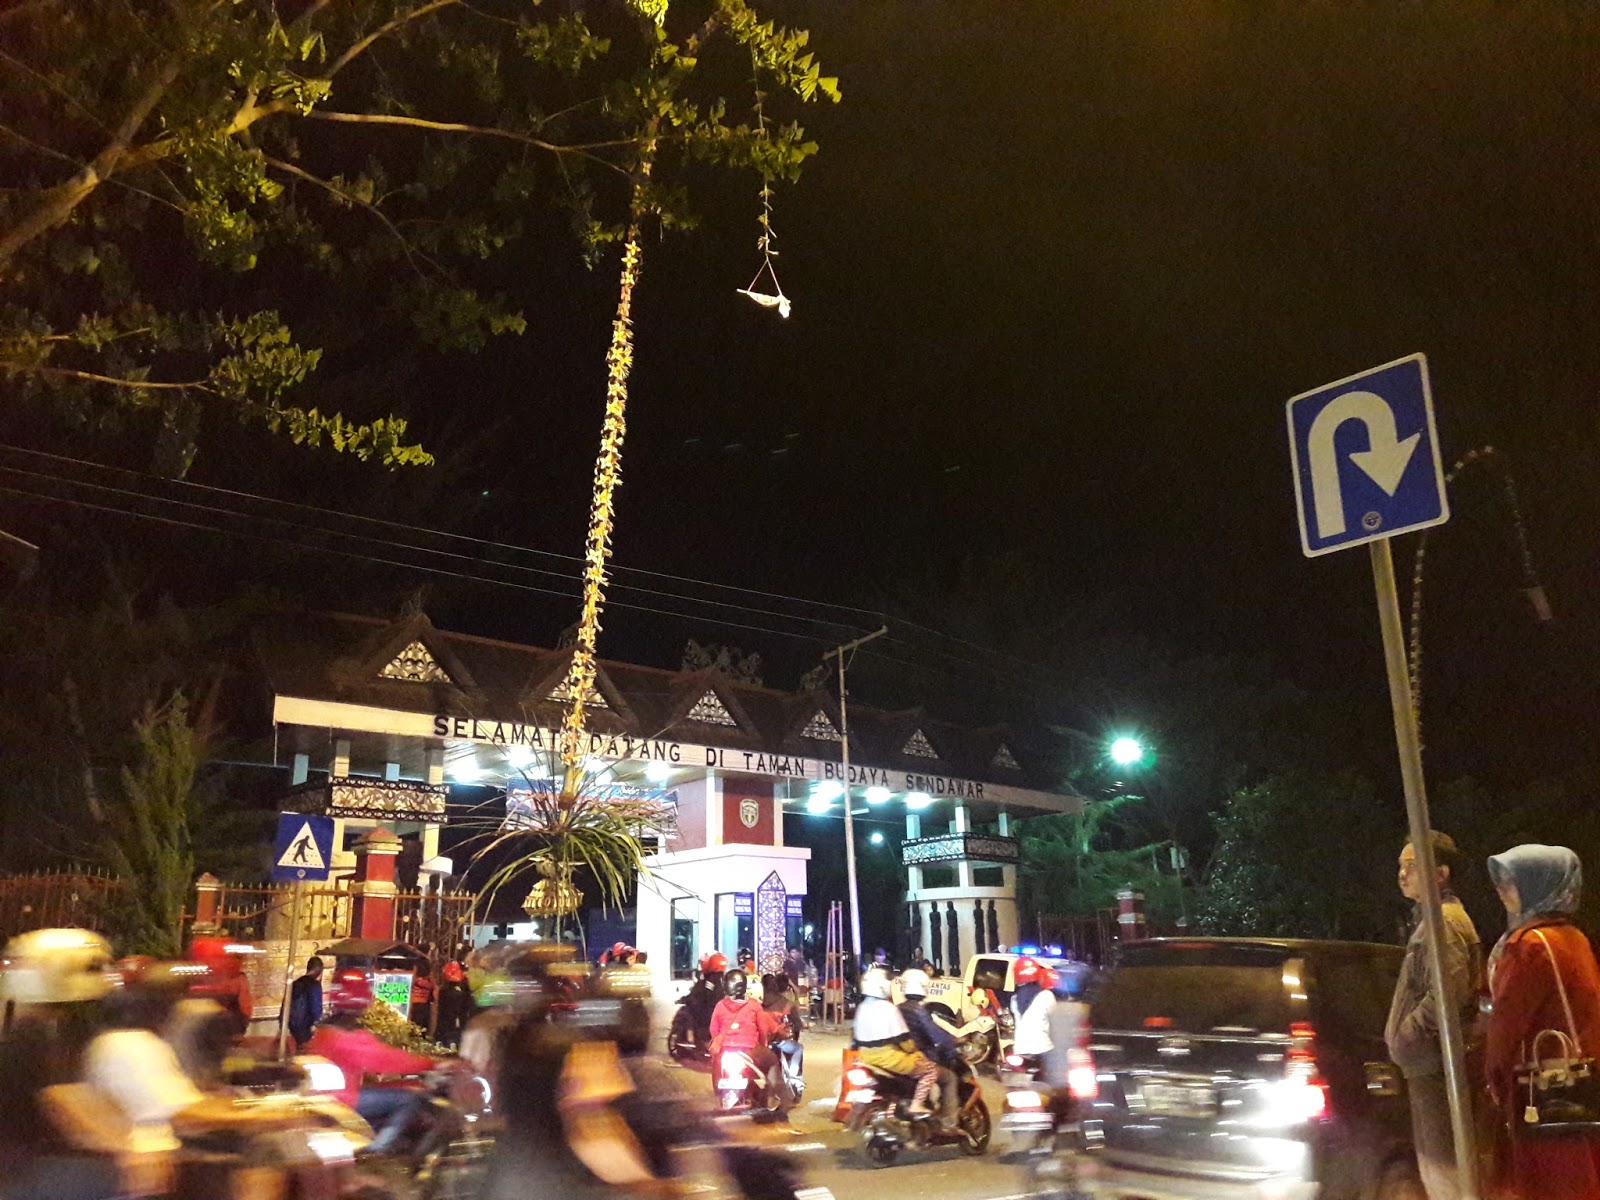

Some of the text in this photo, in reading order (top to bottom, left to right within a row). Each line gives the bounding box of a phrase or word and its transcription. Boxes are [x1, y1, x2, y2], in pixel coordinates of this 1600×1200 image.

[434, 714, 560, 750] SELAMAT
[590, 733, 681, 762] DATANG
[705, 747, 724, 767] DI
[743, 752, 805, 777] TAMAN
[824, 762, 890, 787] BUDAYA
